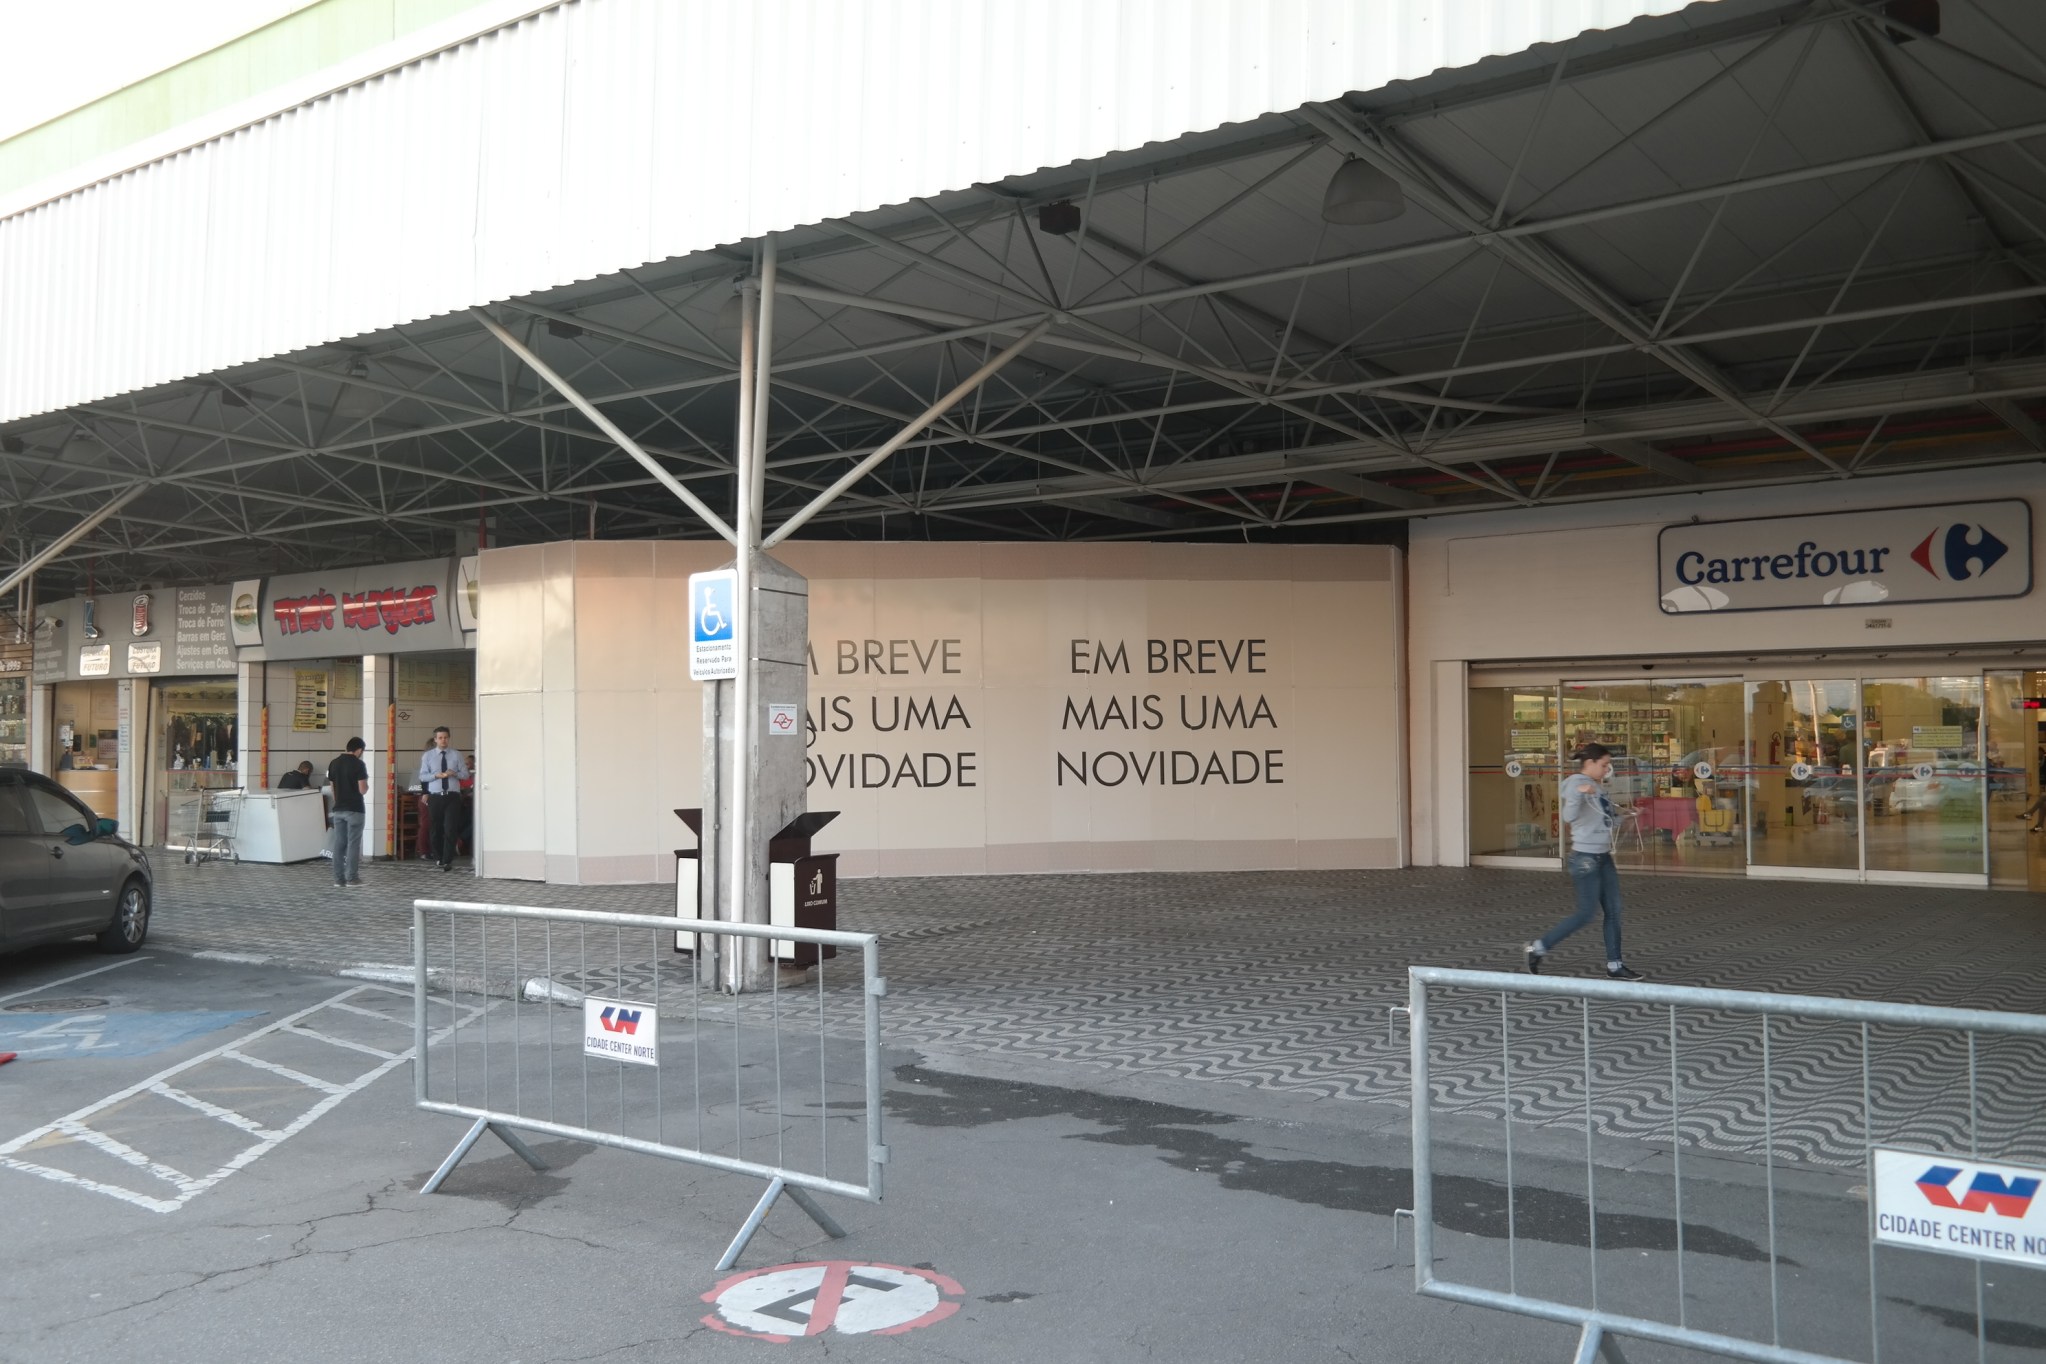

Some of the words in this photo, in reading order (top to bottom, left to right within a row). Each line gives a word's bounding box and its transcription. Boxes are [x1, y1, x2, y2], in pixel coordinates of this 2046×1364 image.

[1675, 541, 1891, 586] Carrefour
[178, 604, 197, 614] Troca
[197, 603, 206, 614] de
[178, 617, 197, 628] Troca
[197, 617, 206, 628] de
[837, 639, 962, 675] BREVE
[1071, 639, 1131, 675] EM
[1147, 639, 1267, 675] BREVE
[871, 695, 972, 732] UMA
[1061, 694, 1164, 731] MAIS
[1180, 694, 1278, 731] UMA
[1057, 749, 1284, 786] NOVIDADE
[586, 1036, 608, 1050] CIDADE
[609, 1041, 632, 1055] CENTER
[633, 1045, 654, 1059] NORTE
[1879, 1213, 1942, 1240] CIDADE
[1948, 1223, 2016, 1251] CENTER
